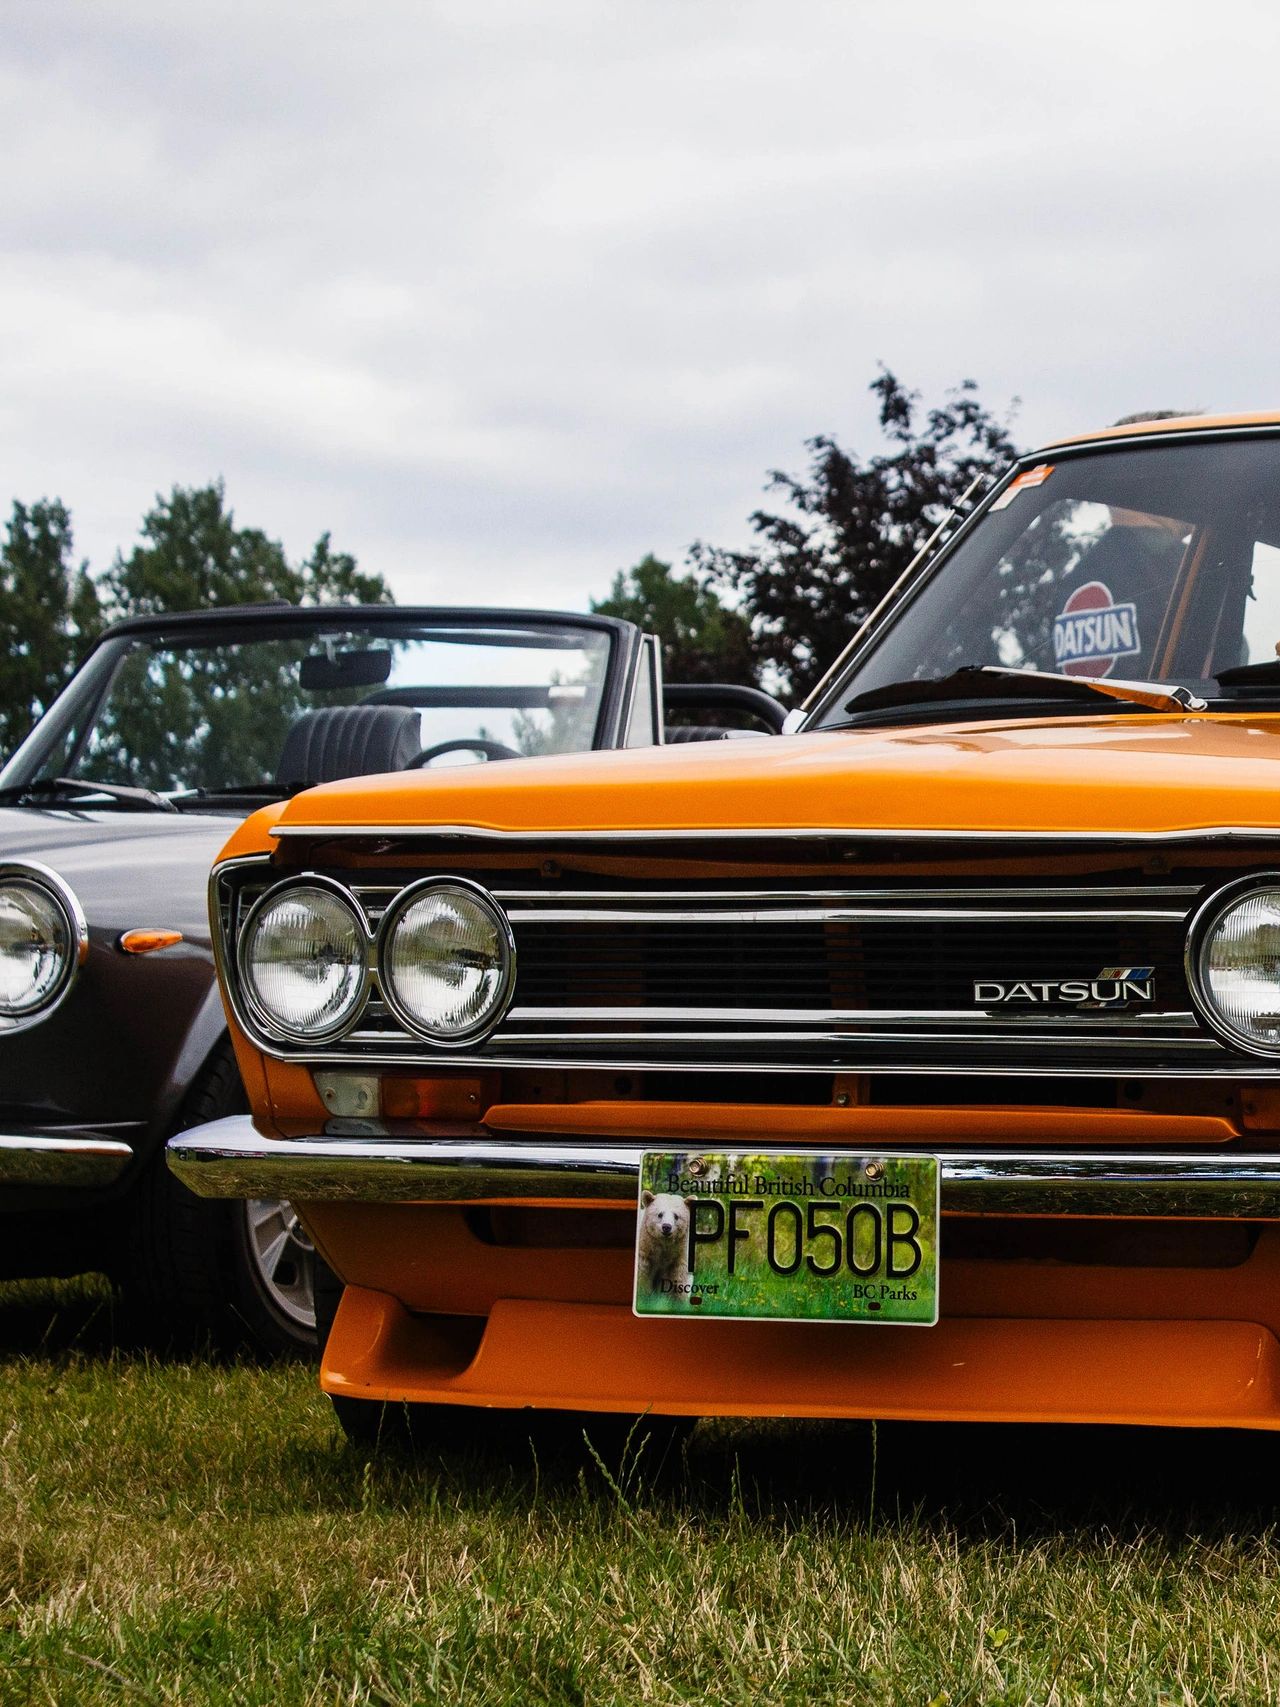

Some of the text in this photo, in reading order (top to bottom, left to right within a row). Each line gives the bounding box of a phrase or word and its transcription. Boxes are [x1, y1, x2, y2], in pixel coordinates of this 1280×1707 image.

[1054, 611, 1133, 659] DATSUN
[974, 981, 1151, 1002] DATSUN
[668, 1174, 910, 1199] Beautiful British Columbia
[661, 1279, 720, 1295] Discover
[853, 1284, 918, 1301] BC Parks
